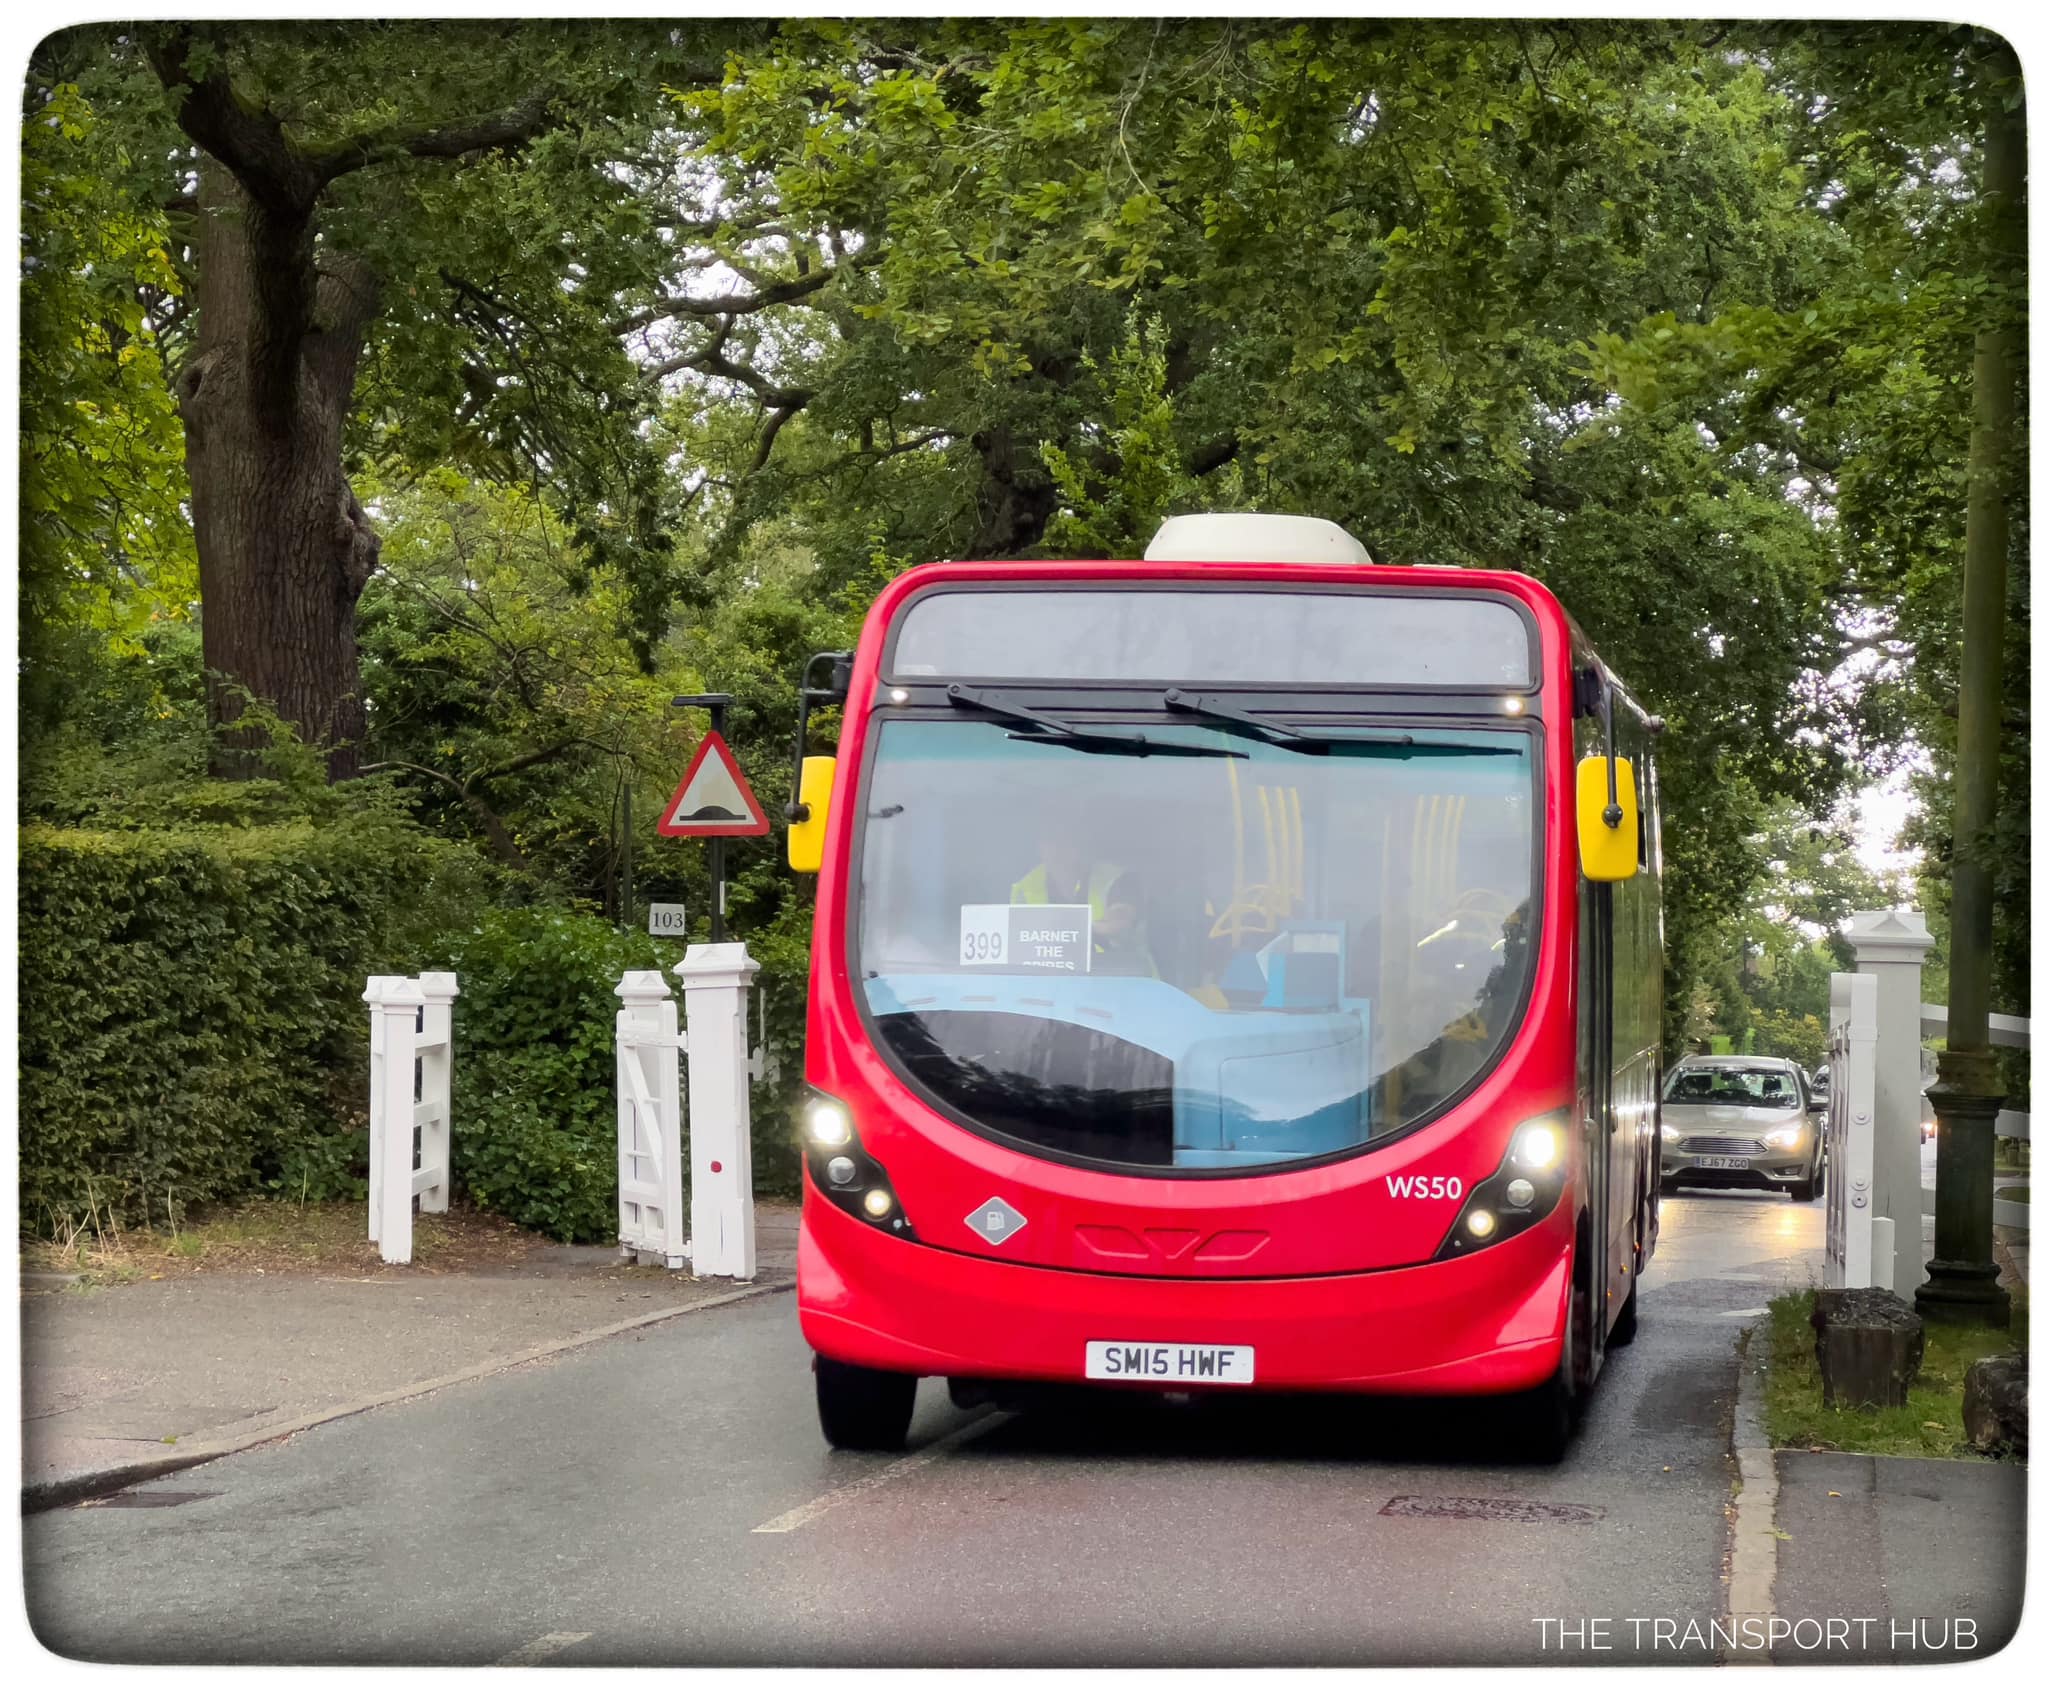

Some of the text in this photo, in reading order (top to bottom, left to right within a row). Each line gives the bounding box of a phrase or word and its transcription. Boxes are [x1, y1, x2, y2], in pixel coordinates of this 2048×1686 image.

[653, 912, 683, 929] 103
[964, 931, 1002, 960] 399
[1020, 930, 1079, 942] BARNET
[1034, 946, 1064, 958] THE
[1385, 1175, 1462, 1200] WS50
[1105, 1347, 1235, 1377] SM15 HWF
